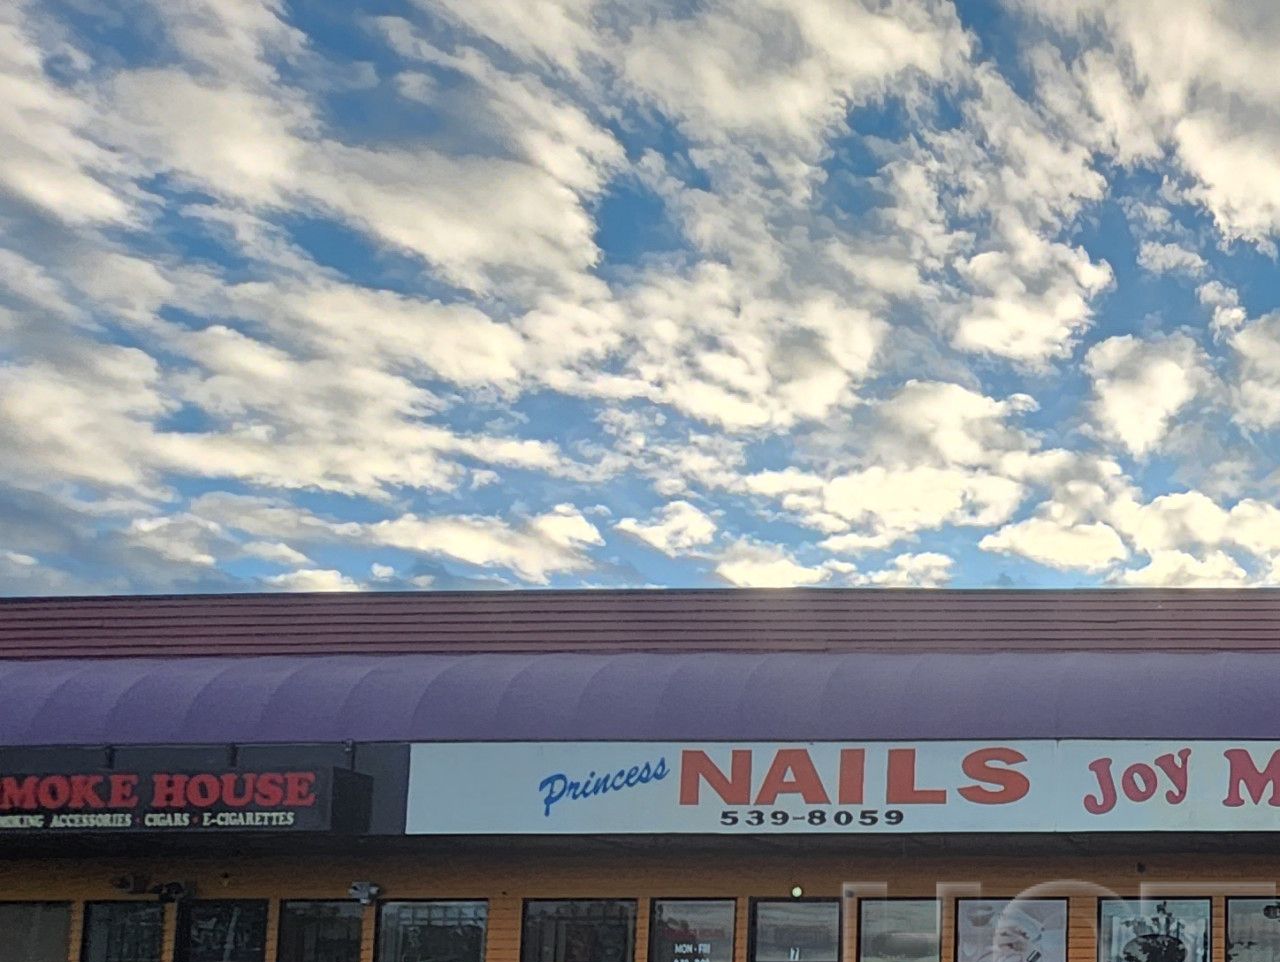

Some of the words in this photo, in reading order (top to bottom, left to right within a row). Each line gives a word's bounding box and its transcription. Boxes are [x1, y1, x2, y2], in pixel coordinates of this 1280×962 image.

[152, 772, 316, 807] HOUSE
[539, 756, 671, 817] Princess
[679, 746, 1031, 806] NAILS
[1083, 747, 1192, 816] Joy
[50, 813, 132, 828] ACCESSORIES
[145, 812, 190, 827] CIGARS
[203, 811, 295, 827] E-CIGARETTES
[719, 809, 906, 827] 539-8059
[674, 943, 693, 954] MON
